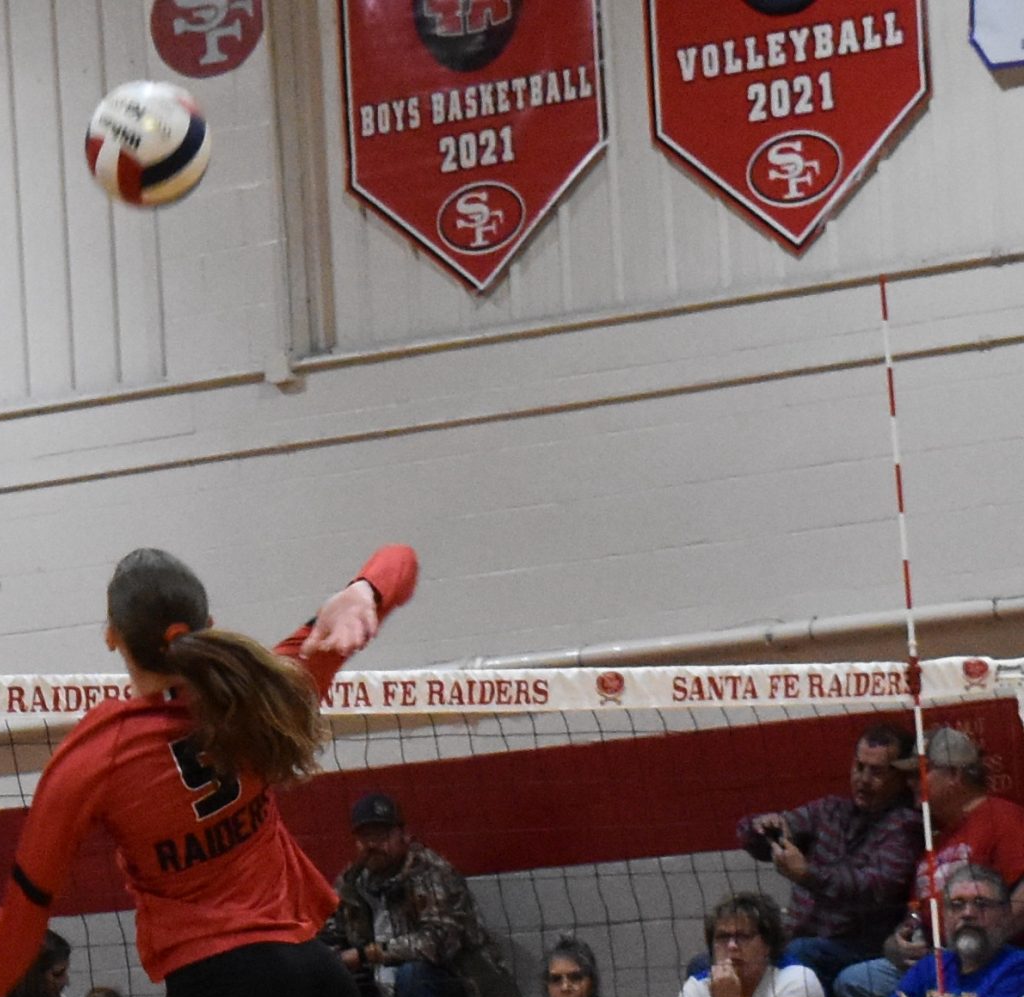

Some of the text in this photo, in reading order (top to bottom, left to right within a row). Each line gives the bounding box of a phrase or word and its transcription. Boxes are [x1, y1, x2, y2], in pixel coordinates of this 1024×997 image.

[677, 11, 904, 82] VOLLEYBALL
[360, 65, 593, 137] BOYS BASKETBALL
[747, 71, 835, 122] 2021
[439, 125, 515, 173] 2021
[320, 678, 549, 708] NTA FE RAIDERS
[672, 675, 759, 702] SANTA
[768, 673, 800, 699] FE
[154, 796, 267, 873] RAIDER
